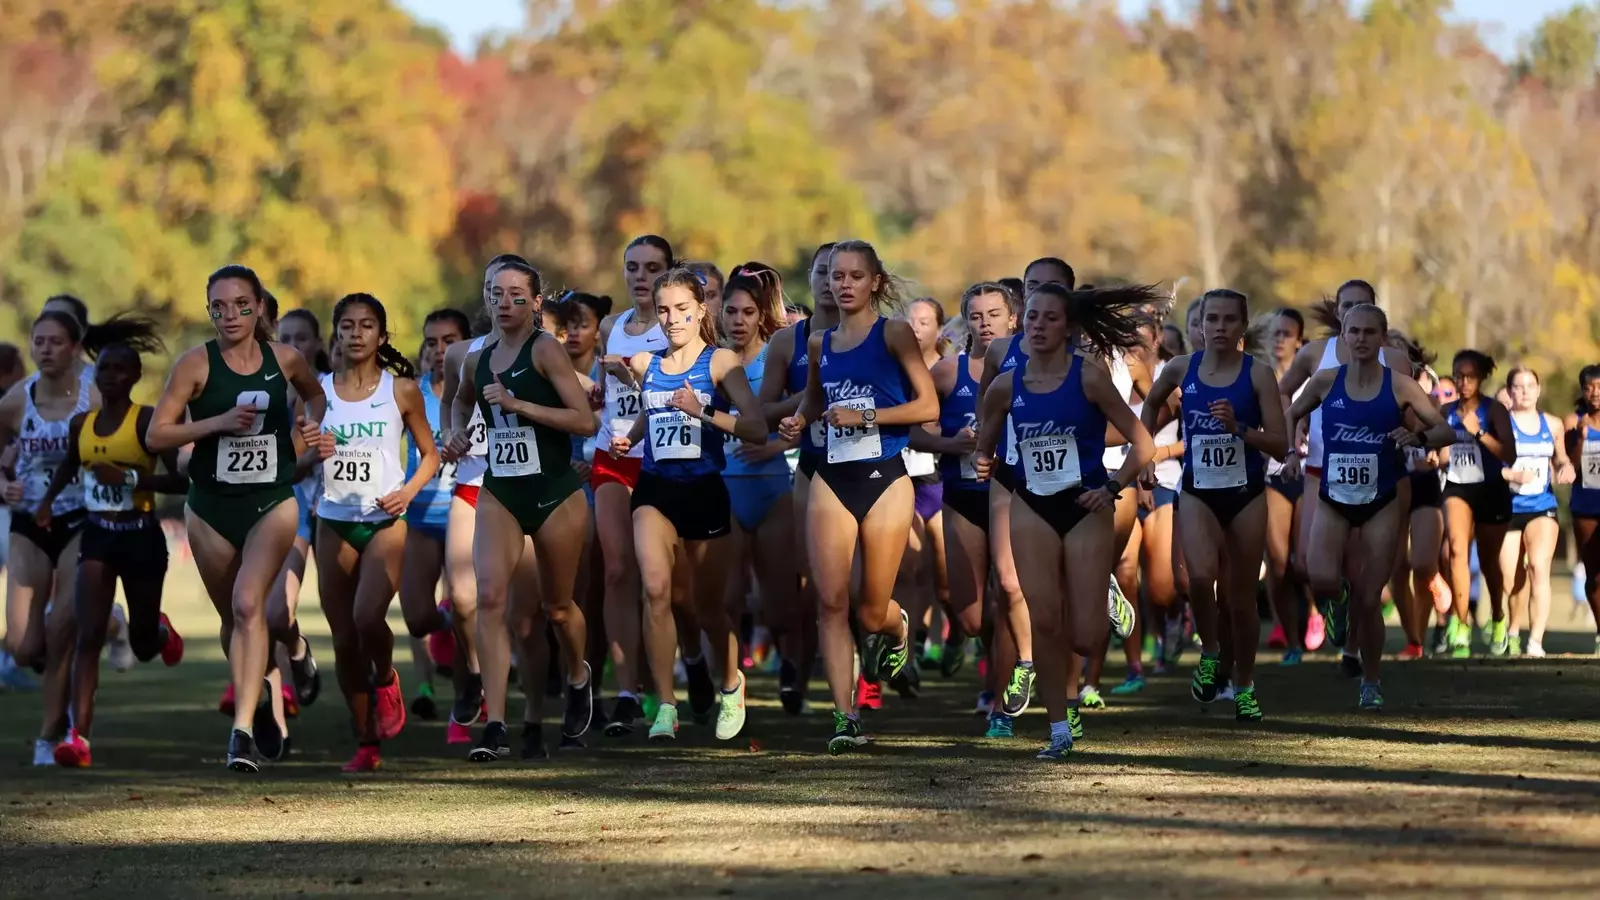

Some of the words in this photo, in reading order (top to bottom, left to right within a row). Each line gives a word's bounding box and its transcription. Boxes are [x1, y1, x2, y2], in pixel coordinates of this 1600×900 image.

[656, 414, 692, 424] AMERICAN
[655, 425, 691, 448] 276
[1018, 420, 1076, 441] Tulsa
[1331, 422, 1386, 444] Tulsa
[229, 438, 269, 448] AMERICAN
[333, 449, 372, 458] AMERICAN
[494, 441, 529, 465] 220
[1029, 439, 1067, 449] AMERICAN
[227, 449, 268, 472] 223
[1032, 449, 1068, 472] 397
[1201, 446, 1237, 467] 402
[1336, 456, 1370, 464] AMERICAN
[333, 460, 371, 482] 293
[1336, 467, 1370, 485] 396
